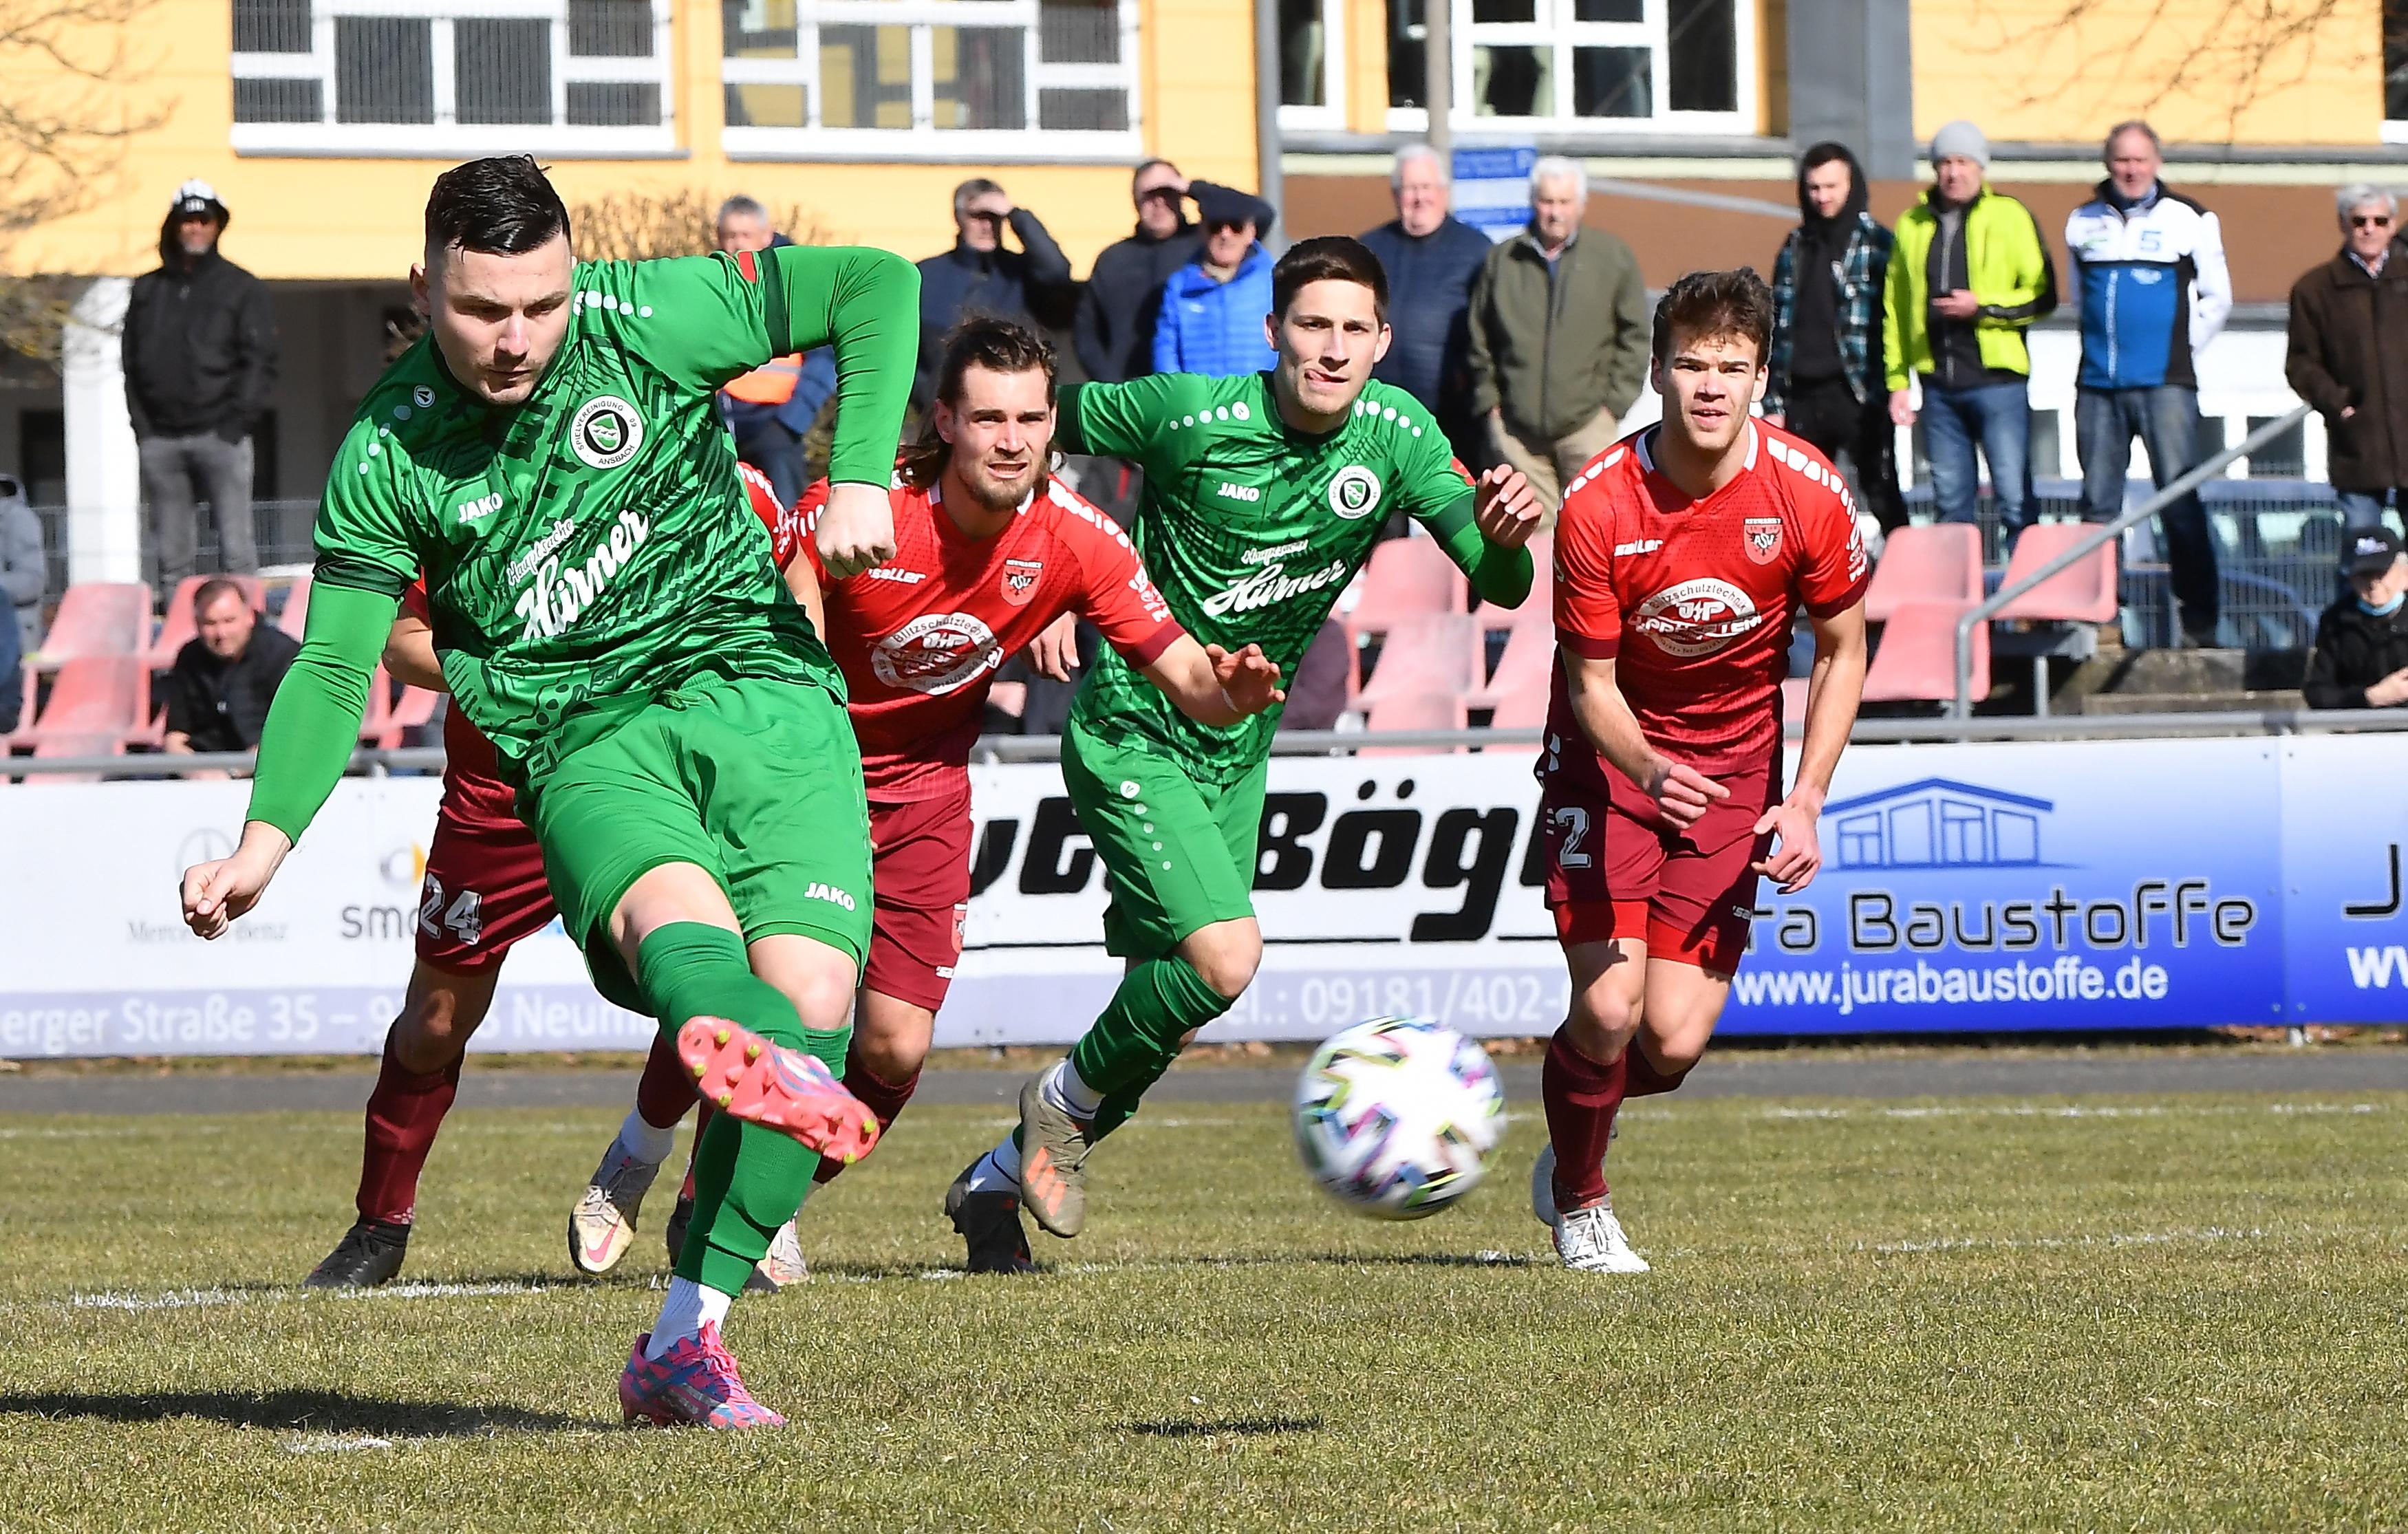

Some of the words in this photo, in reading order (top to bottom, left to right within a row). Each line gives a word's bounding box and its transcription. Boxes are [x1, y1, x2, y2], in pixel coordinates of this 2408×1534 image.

[575, 400, 623, 451] SPIELVEREINIGUNG
[598, 444, 635, 465] ANSBACH
[458, 493, 503, 523] JAKO
[1217, 482, 1260, 502] JAKO
[506, 518, 574, 587] Hauptsache
[1754, 532, 1774, 548] ASV
[1009, 575, 1032, 590] ASV
[420, 872, 482, 945] 24
[804, 882, 856, 912] JAKO
[1849, 879, 2257, 951] Baustoffe
[1734, 955, 2170, 1016] www.jurabaustoffe.de
[1, 1008, 110, 1054] erger
[121, 996, 256, 1042] Straße
[269, 995, 319, 1041] 35
